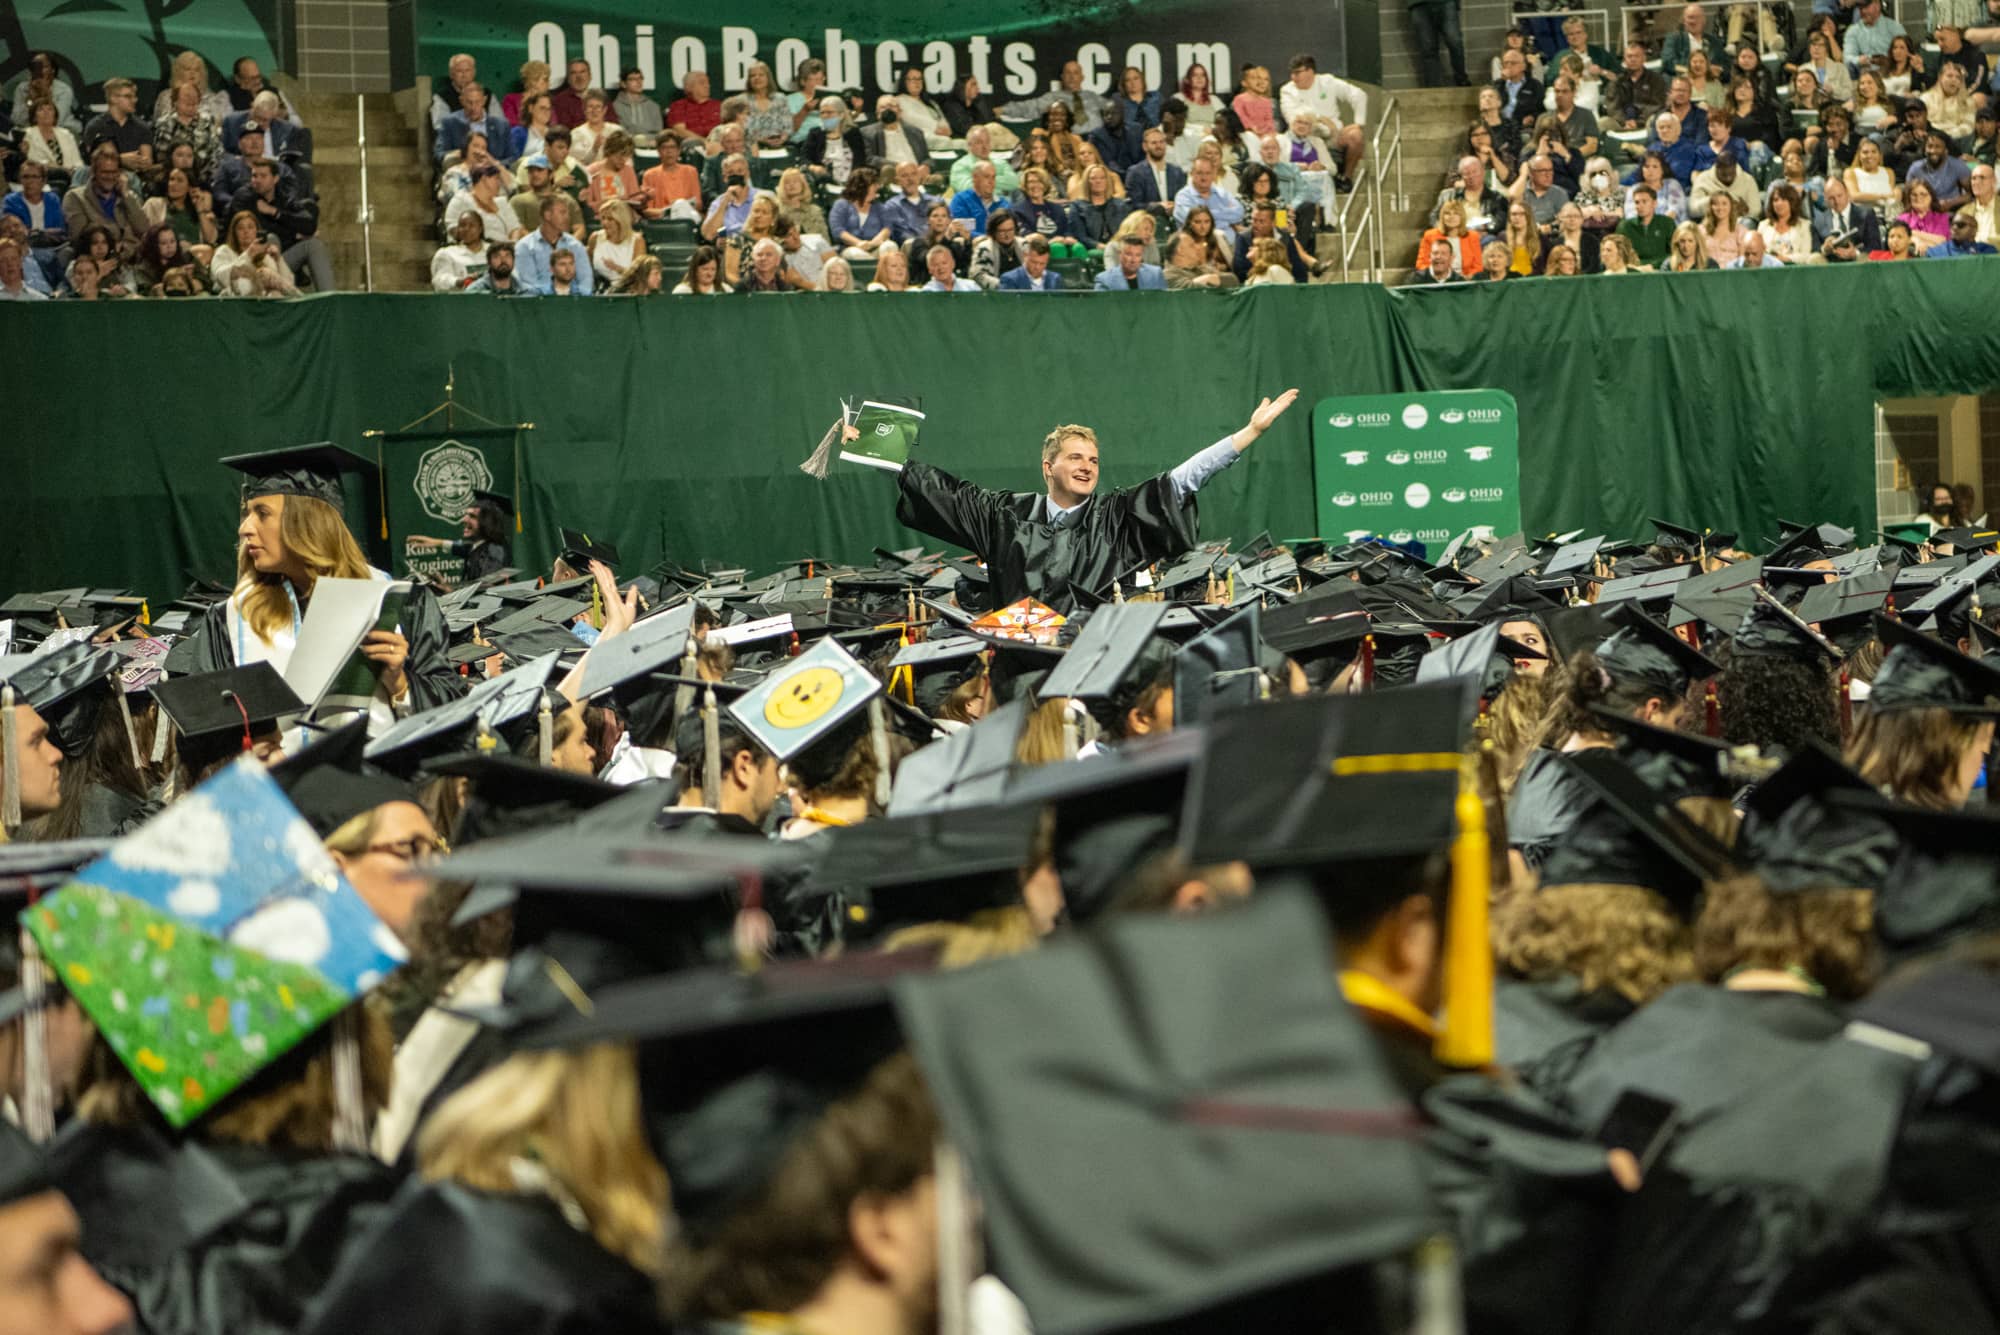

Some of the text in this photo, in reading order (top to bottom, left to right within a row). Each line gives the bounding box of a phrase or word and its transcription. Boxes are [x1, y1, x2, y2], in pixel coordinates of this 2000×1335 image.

[528, 22, 1232, 96] OhioBobcats.com
[1357, 413, 1391, 422] OHIO
[1467, 409, 1502, 419] OHIO
[1414, 450, 1448, 460] OHIO
[1360, 492, 1394, 501] OHIO
[1469, 488, 1503, 497] OHIO
[1416, 529, 1450, 540] OHIO
